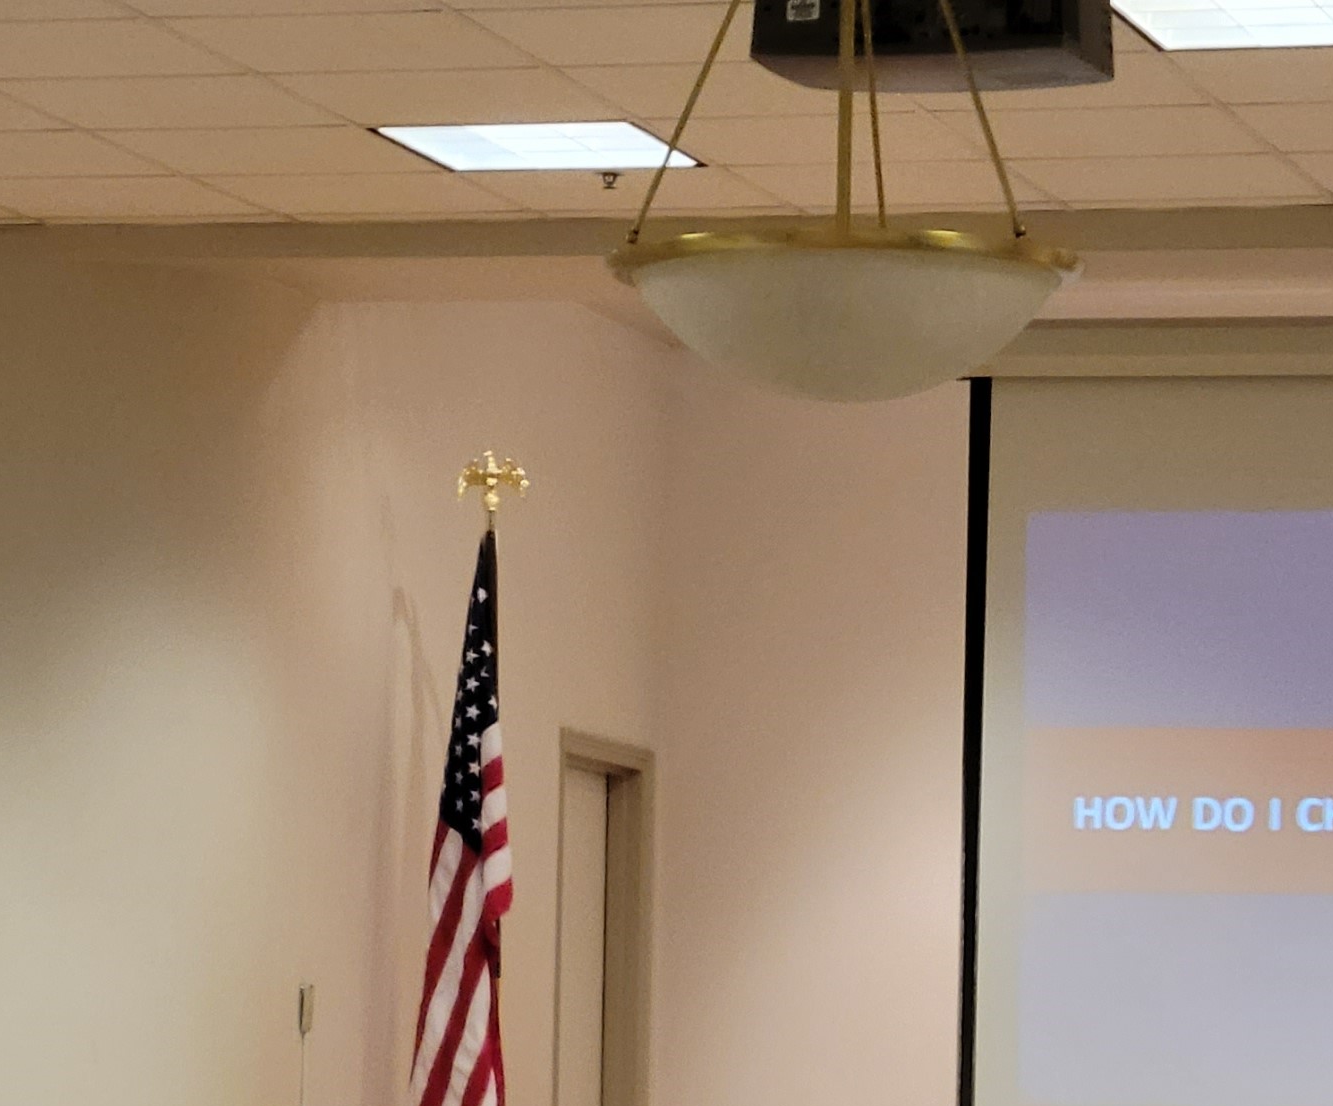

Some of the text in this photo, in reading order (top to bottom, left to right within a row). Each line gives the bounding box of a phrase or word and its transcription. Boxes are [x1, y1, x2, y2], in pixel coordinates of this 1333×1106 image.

[1072, 796, 1178, 832] HOW
[1191, 796, 1254, 833] DO
[1267, 797, 1283, 832] I
